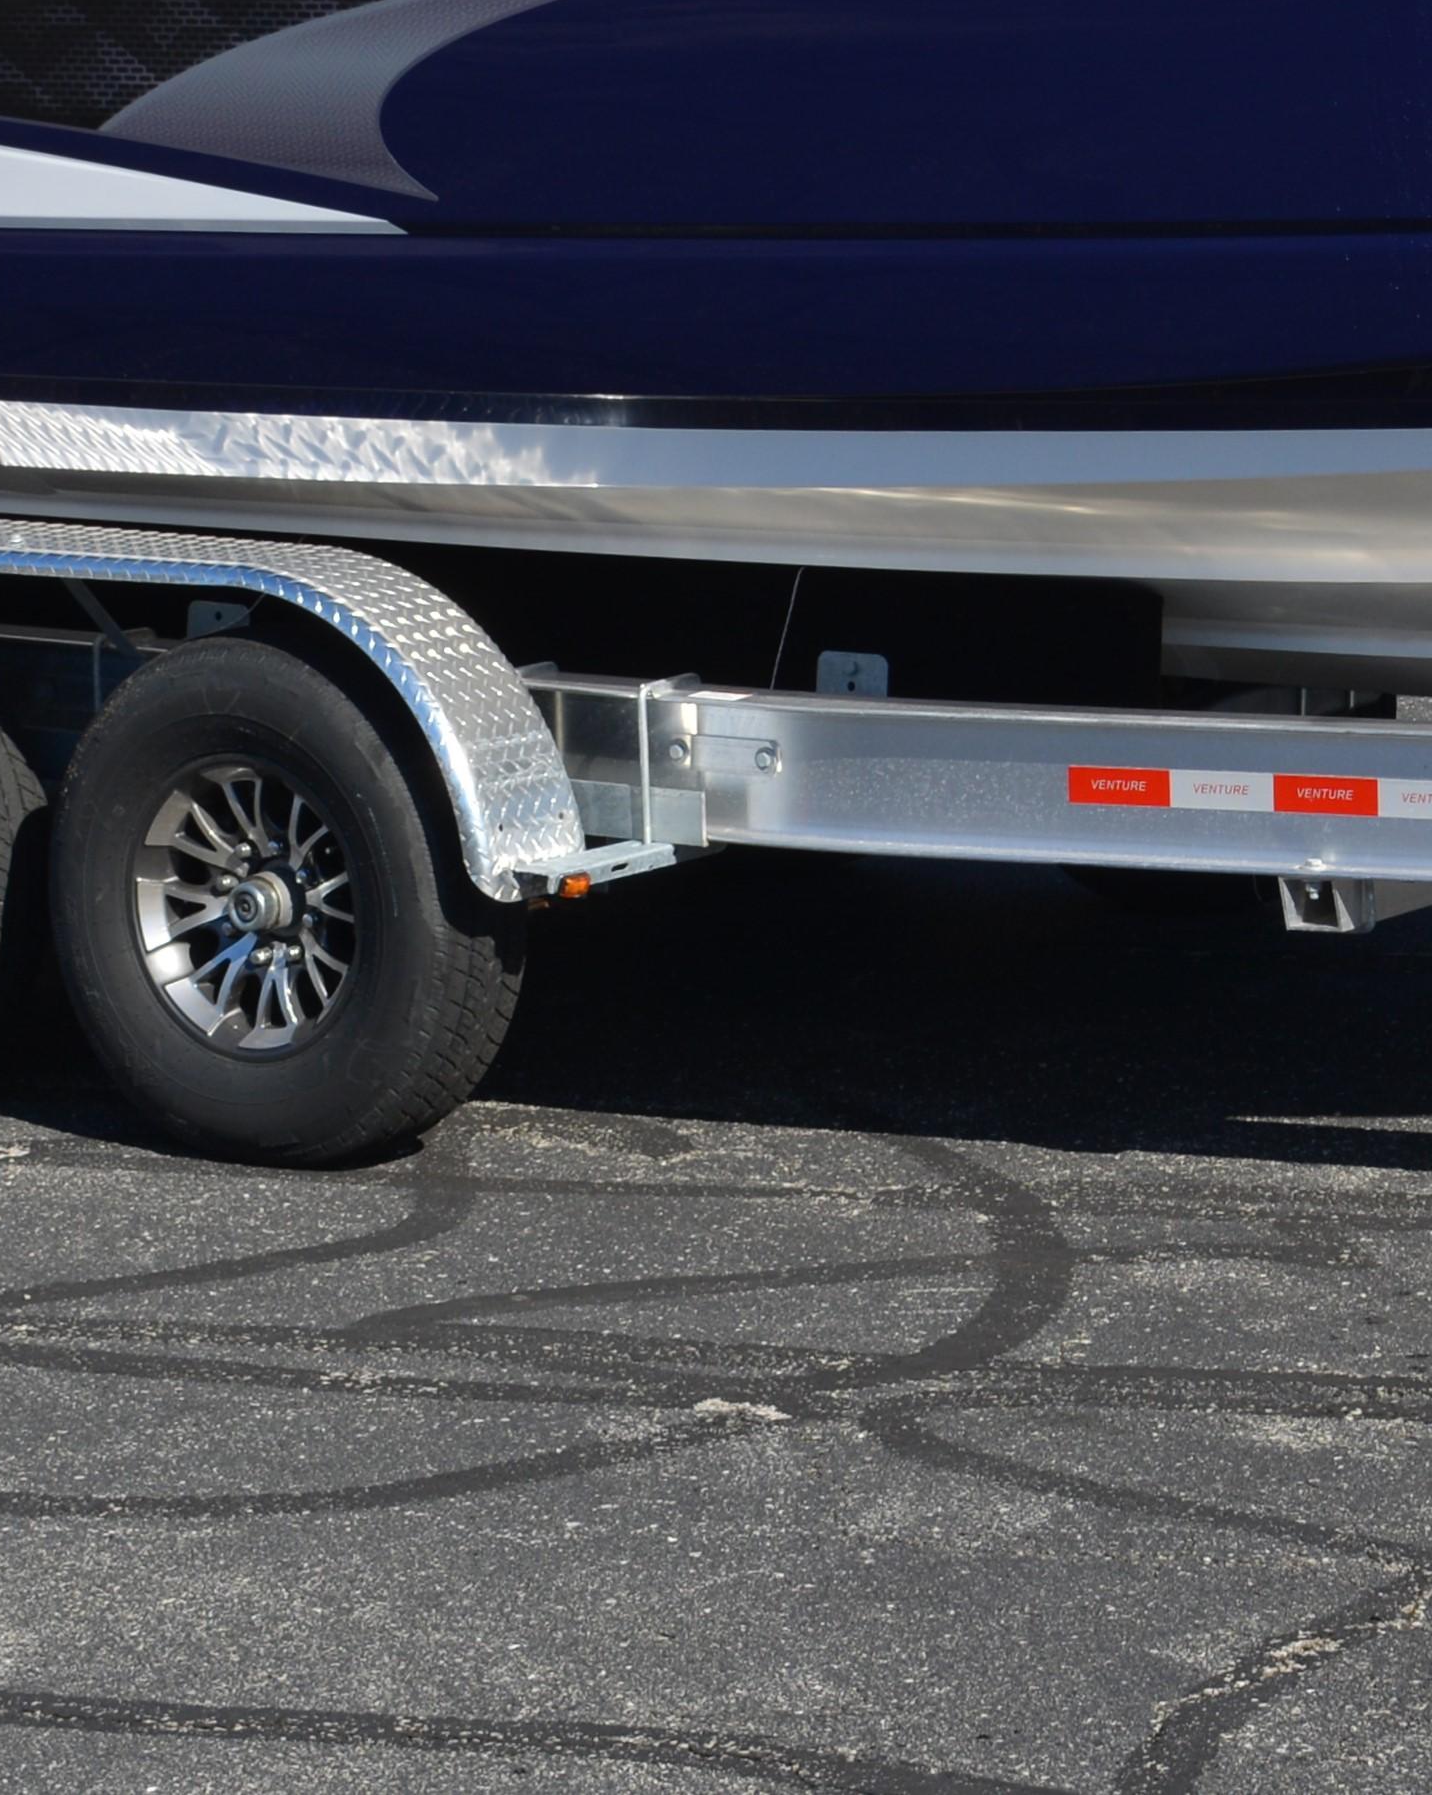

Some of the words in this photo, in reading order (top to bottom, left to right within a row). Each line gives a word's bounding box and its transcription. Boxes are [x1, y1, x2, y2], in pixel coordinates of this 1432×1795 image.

[1091, 779, 1147, 792] VENTURE
[1193, 782, 1249, 796] VENTURE
[1297, 787, 1354, 801] VENTURE
